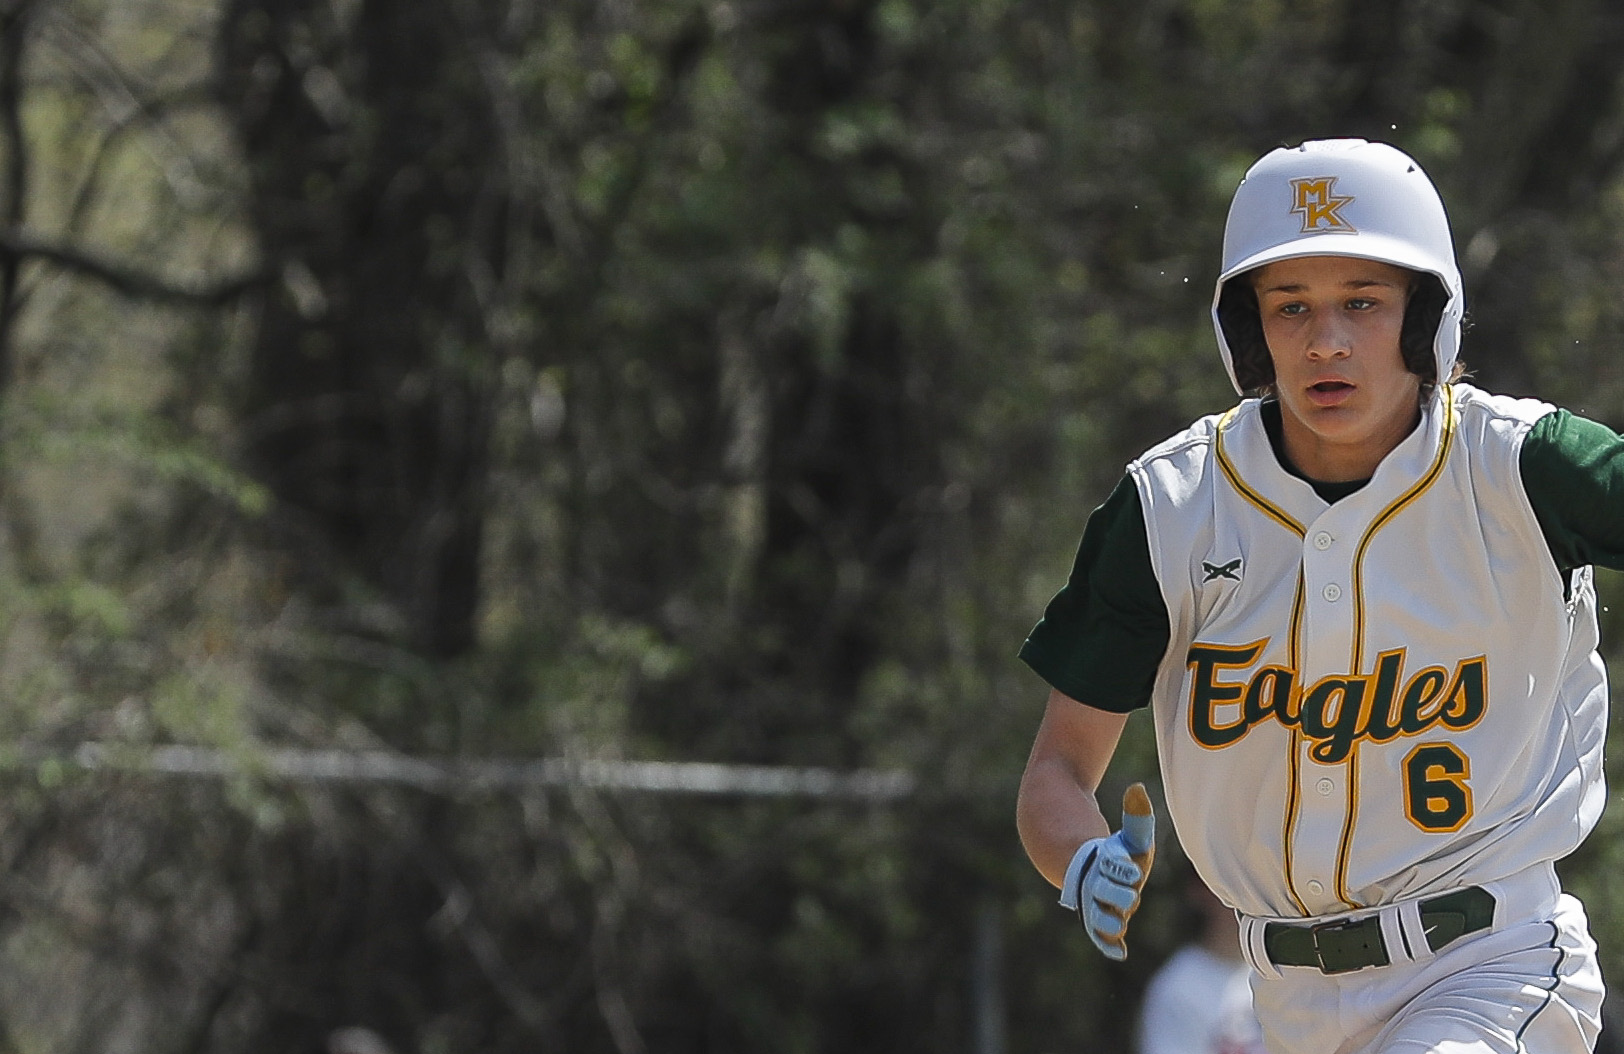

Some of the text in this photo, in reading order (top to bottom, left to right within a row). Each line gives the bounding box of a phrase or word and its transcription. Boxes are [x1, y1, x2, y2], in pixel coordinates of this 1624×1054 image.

[1292, 178, 1354, 232] MK
[1186, 636, 1489, 766] Eagles
[1401, 741, 1473, 833] 6
